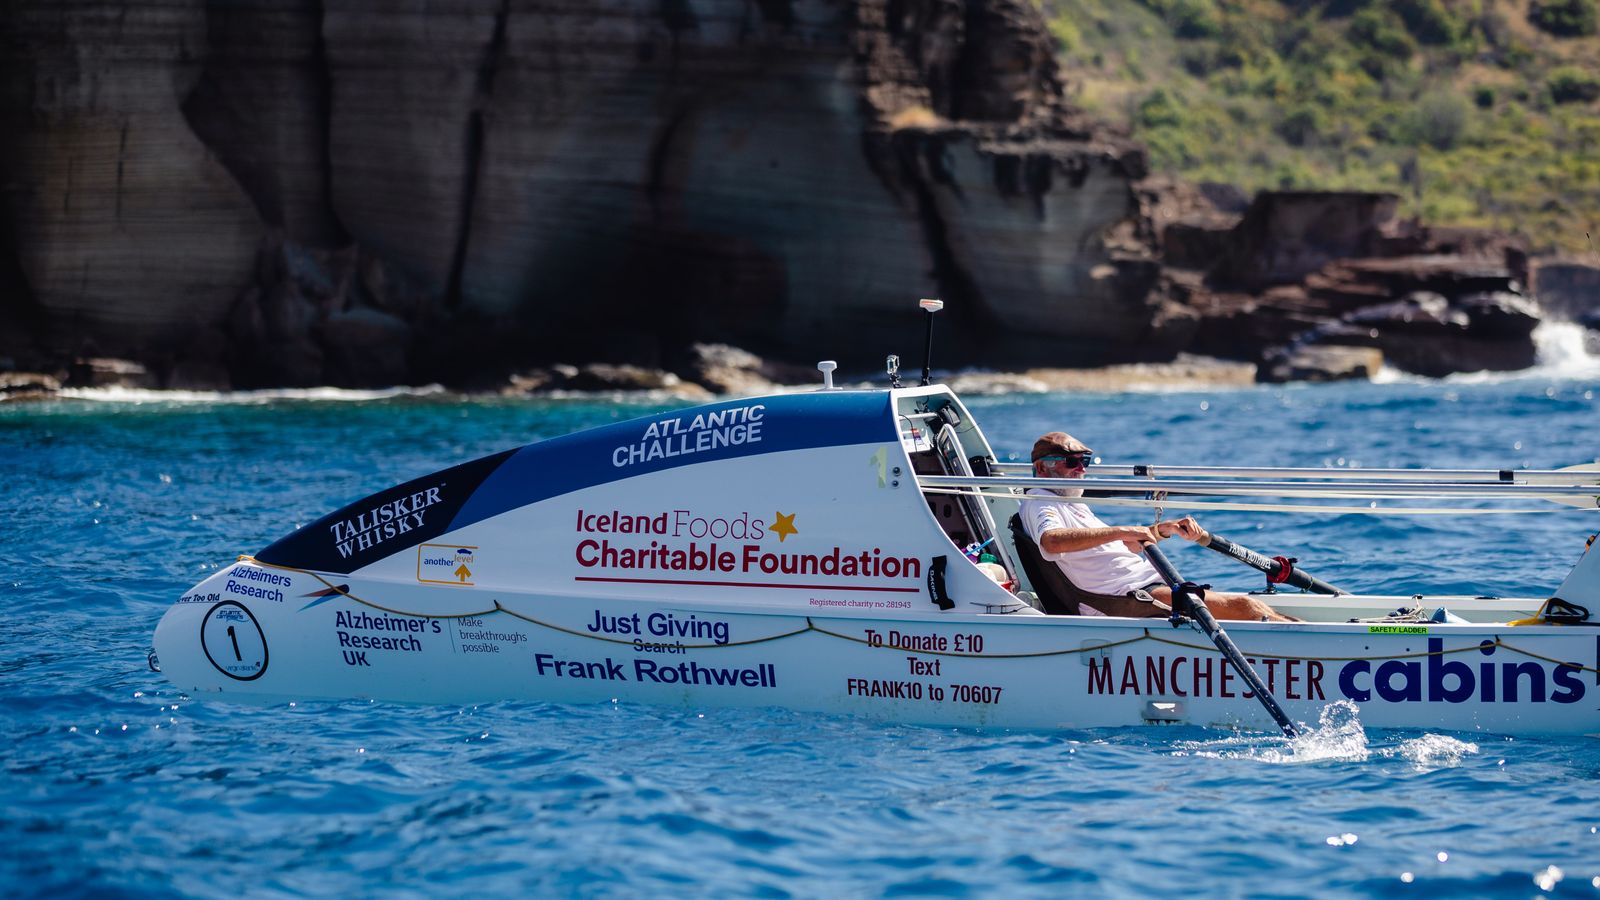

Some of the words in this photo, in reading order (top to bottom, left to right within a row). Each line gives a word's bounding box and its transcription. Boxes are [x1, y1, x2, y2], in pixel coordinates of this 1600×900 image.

[642, 404, 765, 441] ATLANTIC
[612, 422, 763, 468] CHALLENGE
[330, 486, 443, 545] TALISKER
[576, 509, 668, 535] Iceland
[672, 510, 765, 540] Foods
[336, 509, 426, 559] WHISKY
[423, 557, 455, 567] another
[454, 553, 474, 563] level
[575, 539, 736, 572] Charitable
[742, 545, 921, 579] Foundation
[228, 566, 292, 588] Alzheimers
[193, 593, 206, 602] Too
[206, 592, 220, 602] Old
[225, 579, 284, 603] Research
[809, 598, 847, 608] Registered
[848, 600, 873, 609] charity
[886, 601, 912, 609] 281943
[335, 611, 442, 634] Alzheimer's
[457, 617, 483, 628] Make
[587, 610, 641, 635] Just
[647, 613, 729, 645] Giving
[227, 626, 242, 661] 1
[337, 631, 422, 652] Research
[459, 629, 528, 645] breakthroughs
[462, 643, 500, 654] possible
[633, 638, 686, 655] Search
[865, 629, 883, 648] To
[889, 631, 948, 651] Donate
[954, 633, 984, 653] £10
[343, 650, 371, 667] UK
[535, 653, 627, 682] Frank
[633, 659, 777, 688] Rothwell
[907, 657, 941, 676] Text
[1087, 655, 1325, 700] MANCHESTER
[1338, 637, 1586, 703] cabins
[847, 678, 922, 700] FRANK10
[928, 684, 944, 701] to
[950, 684, 1002, 704] 70607
